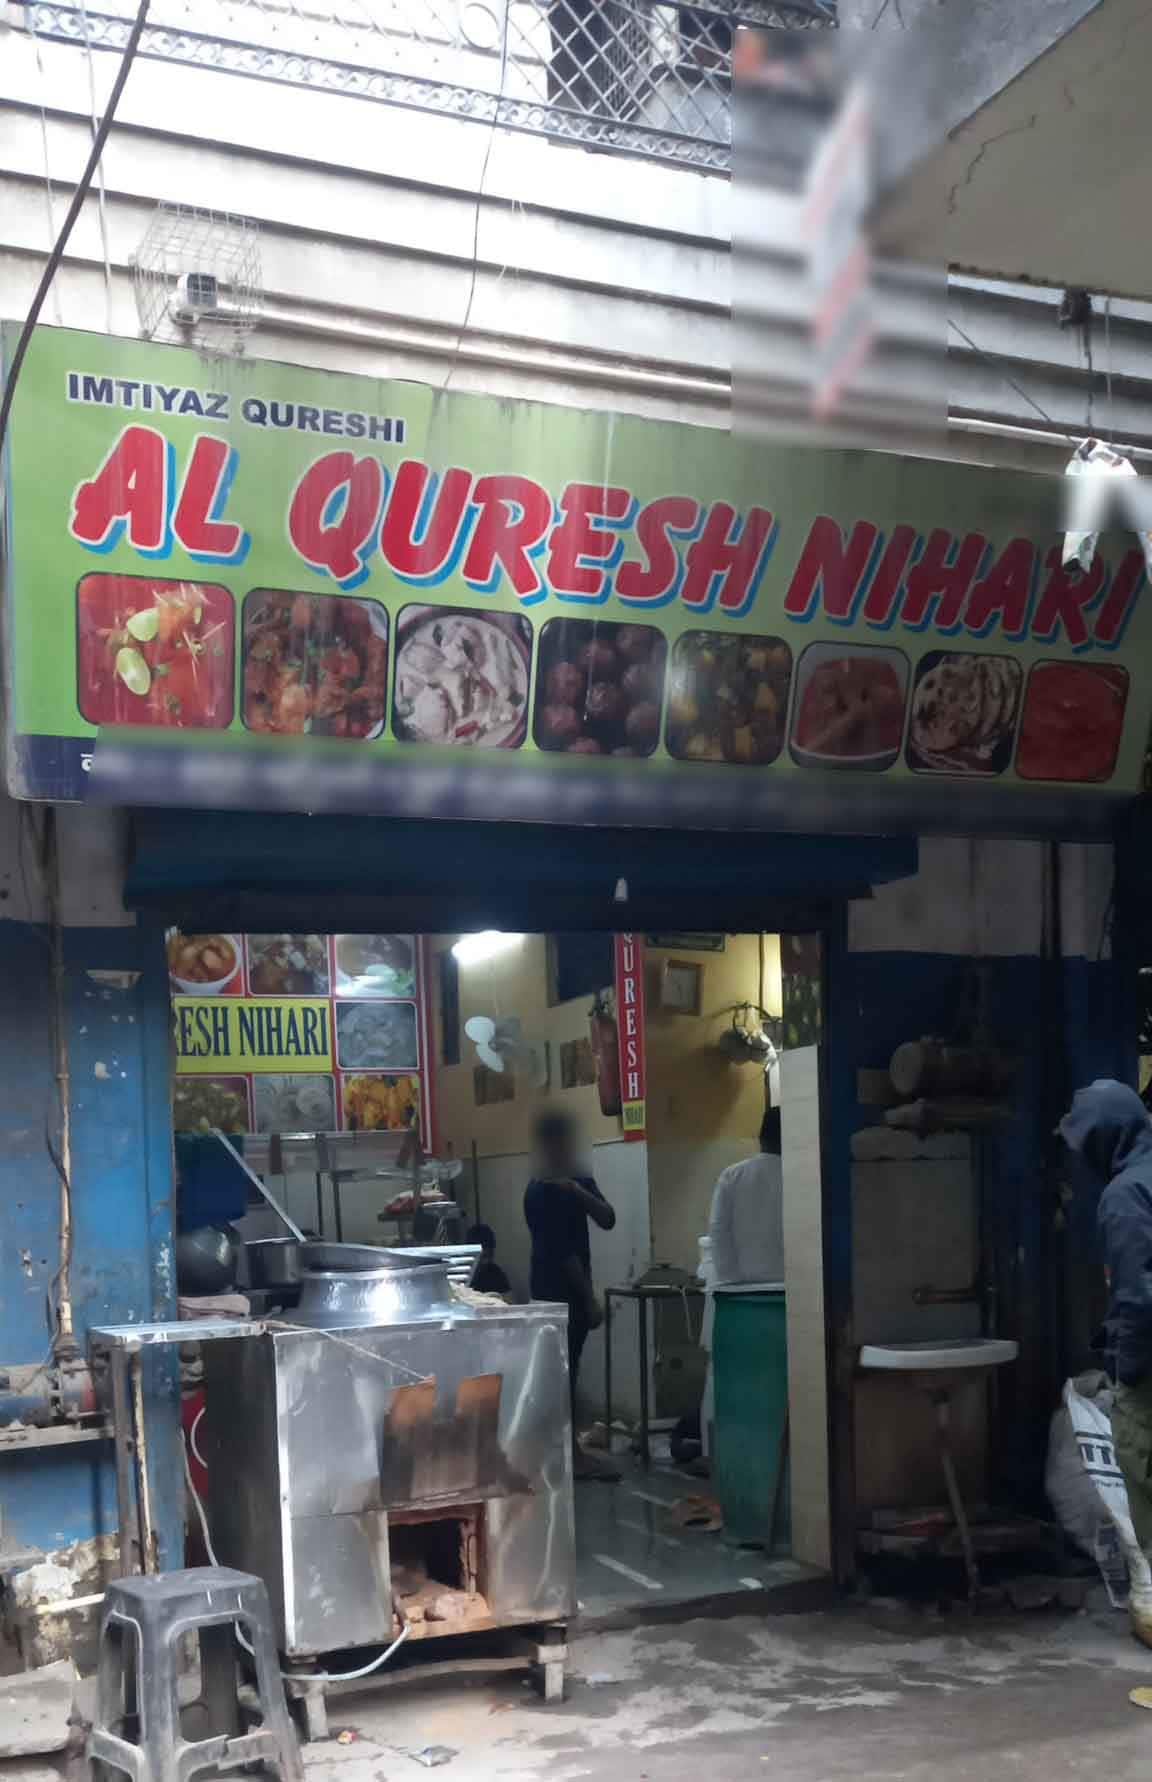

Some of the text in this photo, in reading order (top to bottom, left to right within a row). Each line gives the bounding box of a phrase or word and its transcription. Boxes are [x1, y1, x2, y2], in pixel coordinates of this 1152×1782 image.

[67, 372, 405, 444] IMTIYAZ QURESHI
[69, 424, 1148, 654] AL QURESH NIHARI
[238, 1006, 329, 1057] NIHARI
